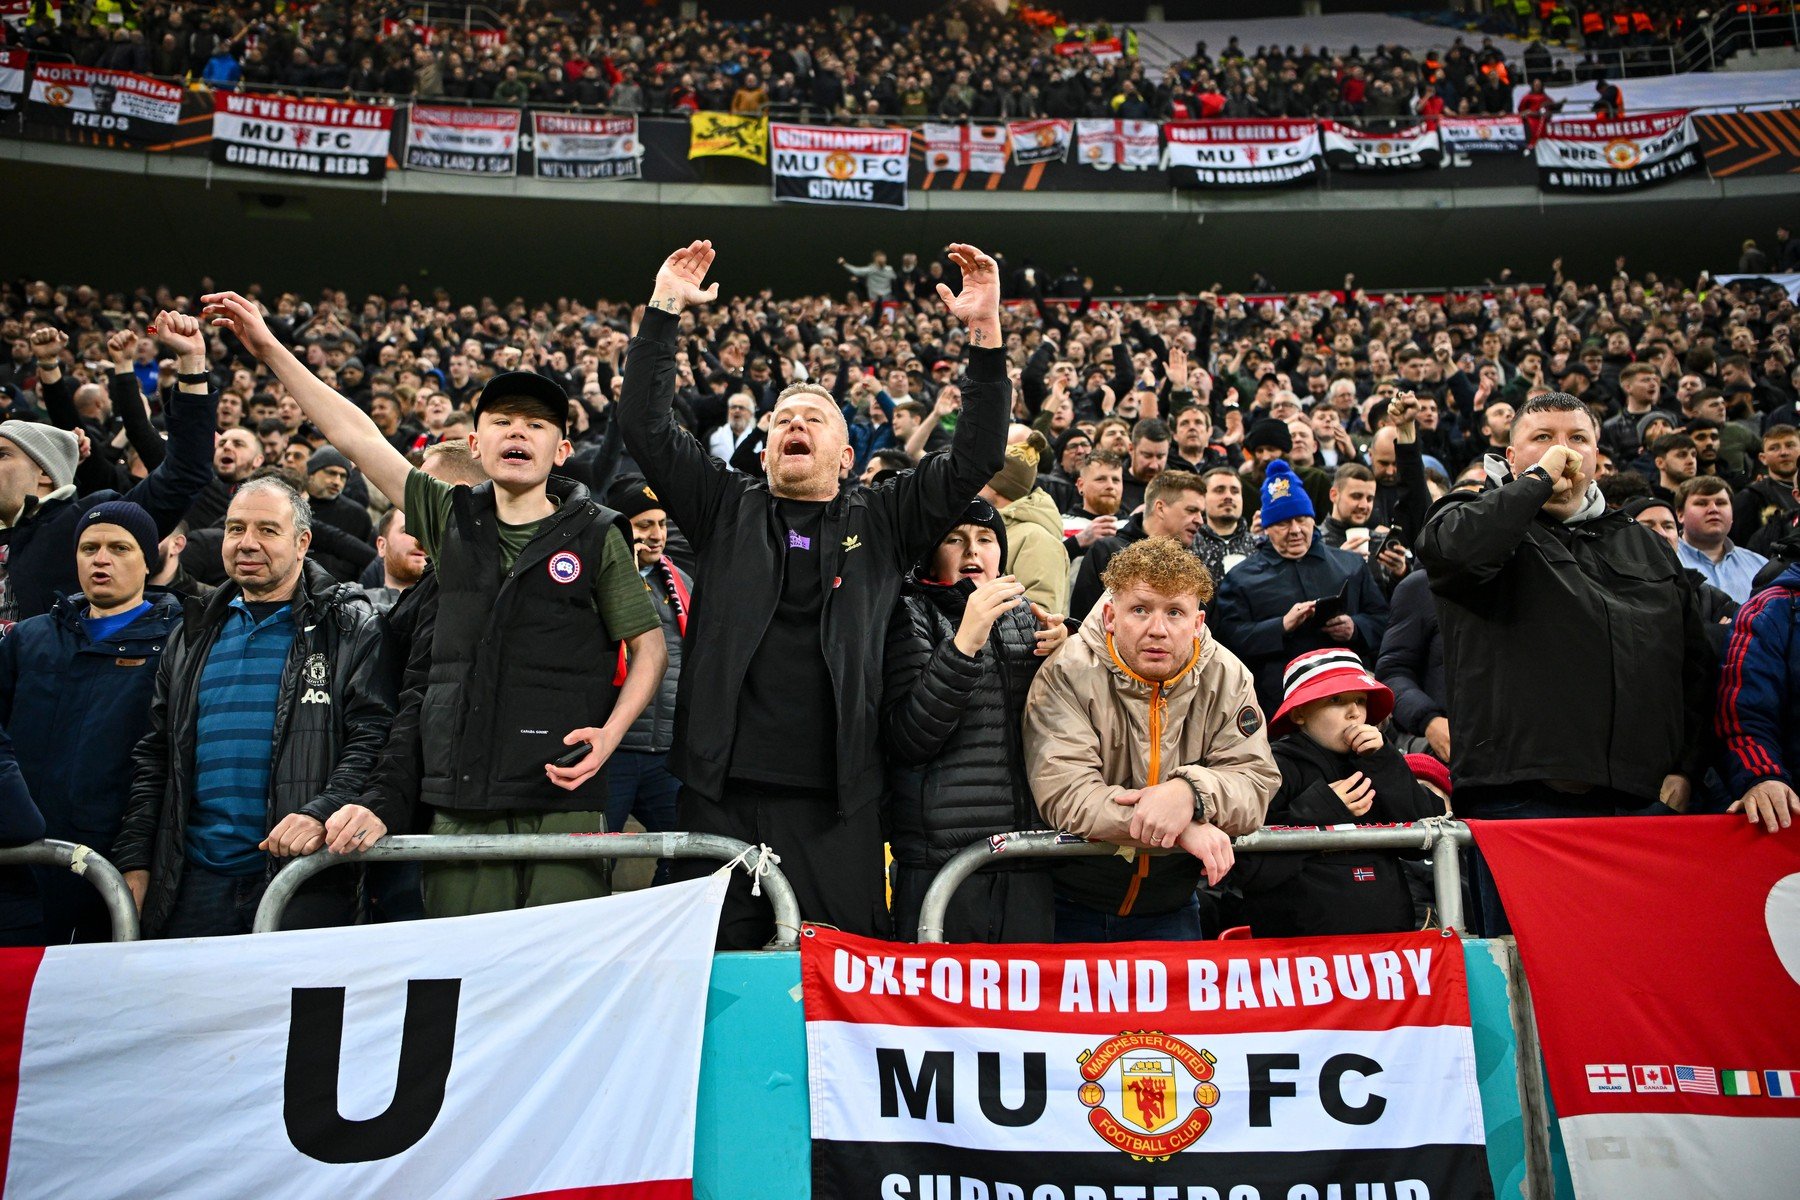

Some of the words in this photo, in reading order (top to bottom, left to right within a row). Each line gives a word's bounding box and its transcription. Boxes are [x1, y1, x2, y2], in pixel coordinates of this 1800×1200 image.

[37, 66, 182, 100] NORTHUMBRIAN
[72, 111, 129, 131] REDS
[227, 95, 280, 118] WE'VE
[285, 102, 327, 123] SEEN
[331, 107, 349, 124] IT
[353, 109, 382, 127] ALL
[241, 123, 284, 142] MU
[317, 132, 352, 148] FC
[776, 129, 903, 153] NORTHAMPTON
[1172, 127, 1207, 141] FROM
[1211, 126, 1234, 140] THE
[1236, 125, 1274, 140] GREEN
[1277, 126, 1287, 139] &
[226, 145, 320, 172] GIBRALTAR
[324, 156, 370, 175] REDS
[777, 154, 819, 171] MU
[862, 158, 902, 176] FC
[1196, 169, 1214, 183] TO
[1562, 172, 1612, 187] UNITED
[1615, 170, 1639, 186] ALL
[808, 180, 873, 200] ROYALS
[833, 948, 1041, 1012] OXFORD
[1059, 959, 1168, 1013] AND
[1187, 947, 1432, 1012] BANBURY
[1086, 1035, 1163, 1076] MANCHESTER
[1165, 1039, 1207, 1075] UNITED
[282, 977, 462, 1165] U
[1099, 1118, 1167, 1152] FOOTBALL
[1169, 1118, 1202, 1148] CLUB
